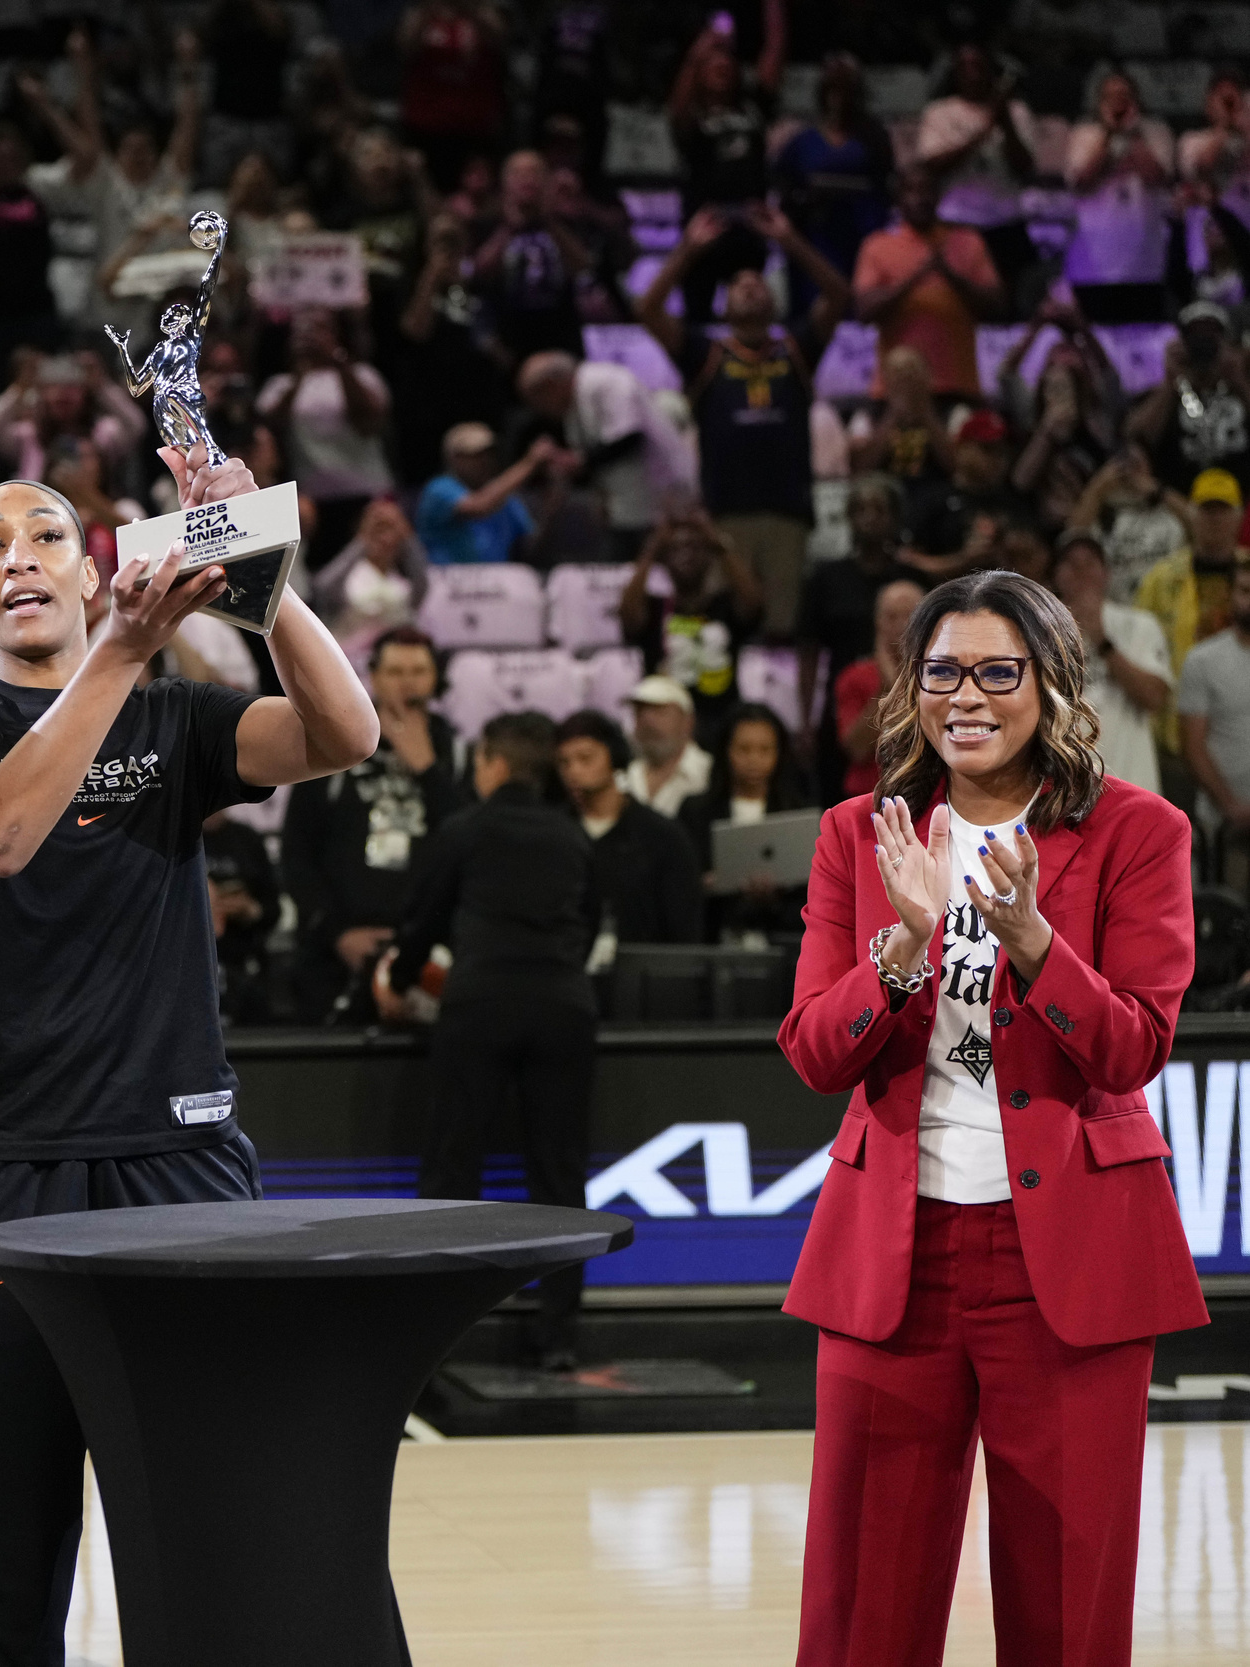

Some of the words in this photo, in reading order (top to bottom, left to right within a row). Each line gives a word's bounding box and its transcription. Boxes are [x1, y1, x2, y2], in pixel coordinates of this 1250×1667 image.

[186, 503, 227, 521] 2025
[190, 538, 222, 550] VALUABLE
[223, 531, 248, 542] PLAYER
[204, 545, 227, 555] WILSON
[87, 749, 159, 780] EGAS
[950, 1049, 993, 1061] ACE
